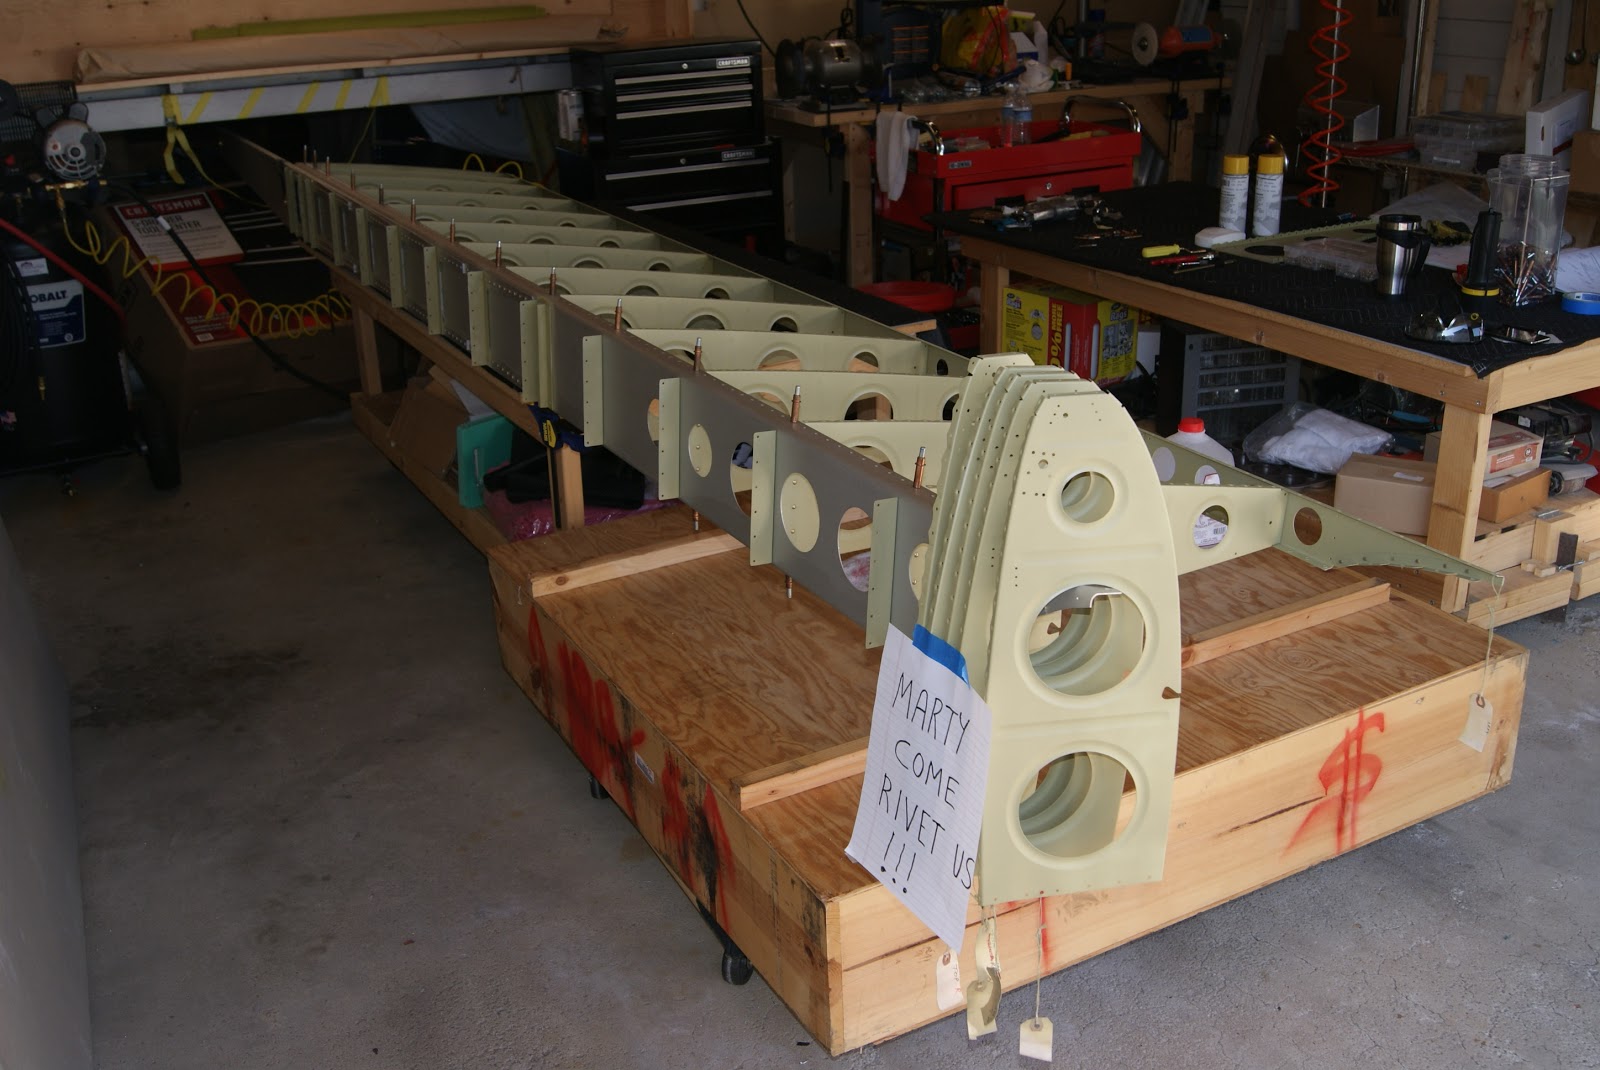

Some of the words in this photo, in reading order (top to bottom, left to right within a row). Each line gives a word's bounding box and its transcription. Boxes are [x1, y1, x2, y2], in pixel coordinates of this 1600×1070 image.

[718, 58, 749, 67] CRAFTSMAN
[29, 289, 67, 303] OBALT
[1110, 310, 1128, 322] Rags
[891, 672, 970, 754] MARTY
[894, 739, 960, 810] COME
[879, 772, 946, 854] RIVET
[952, 843, 976, 890] US
